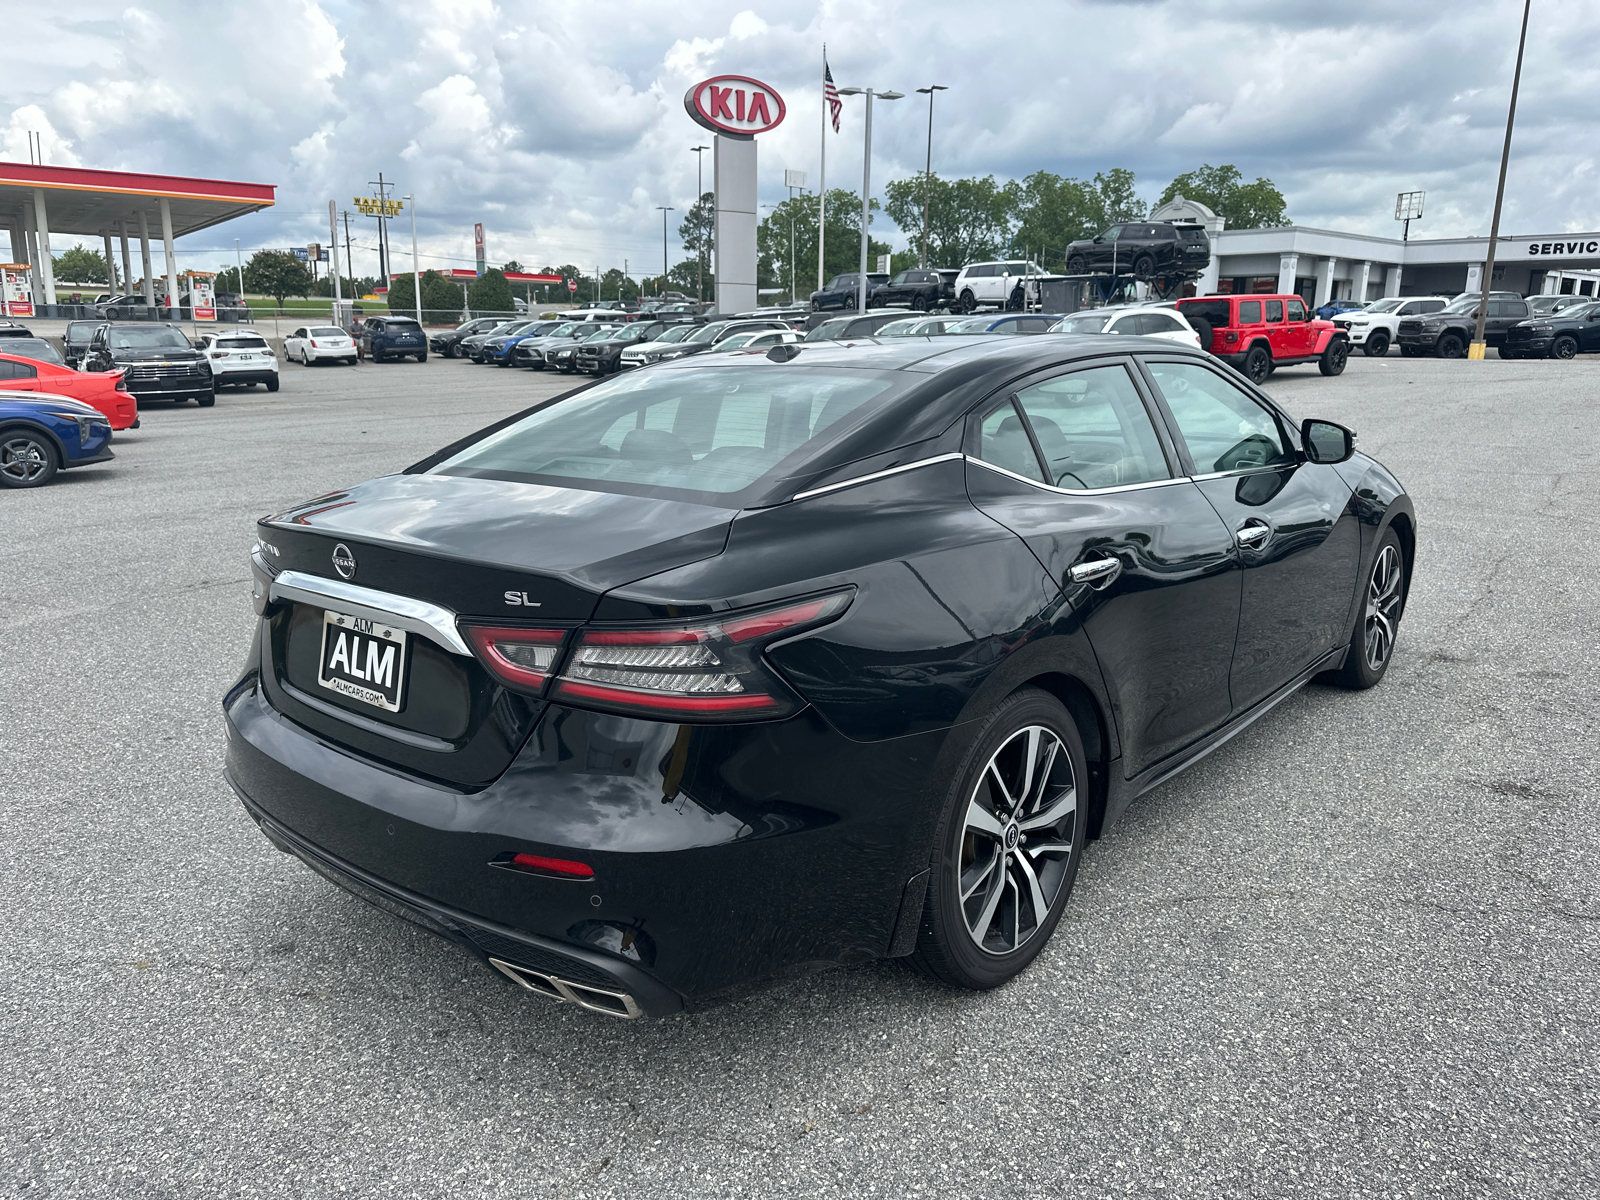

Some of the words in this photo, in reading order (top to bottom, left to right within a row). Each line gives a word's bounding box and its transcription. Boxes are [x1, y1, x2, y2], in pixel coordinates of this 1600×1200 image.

[709, 85, 771, 124] KIA
[353, 197, 403, 208] WAFLE
[359, 206, 399, 215] HOUSE
[1528, 241, 1600, 255] SERVIC
[504, 591, 542, 607] SL
[353, 618, 374, 635] ALM
[329, 631, 396, 689] ALM
[335, 681, 380, 703] ALMCARS.COM
